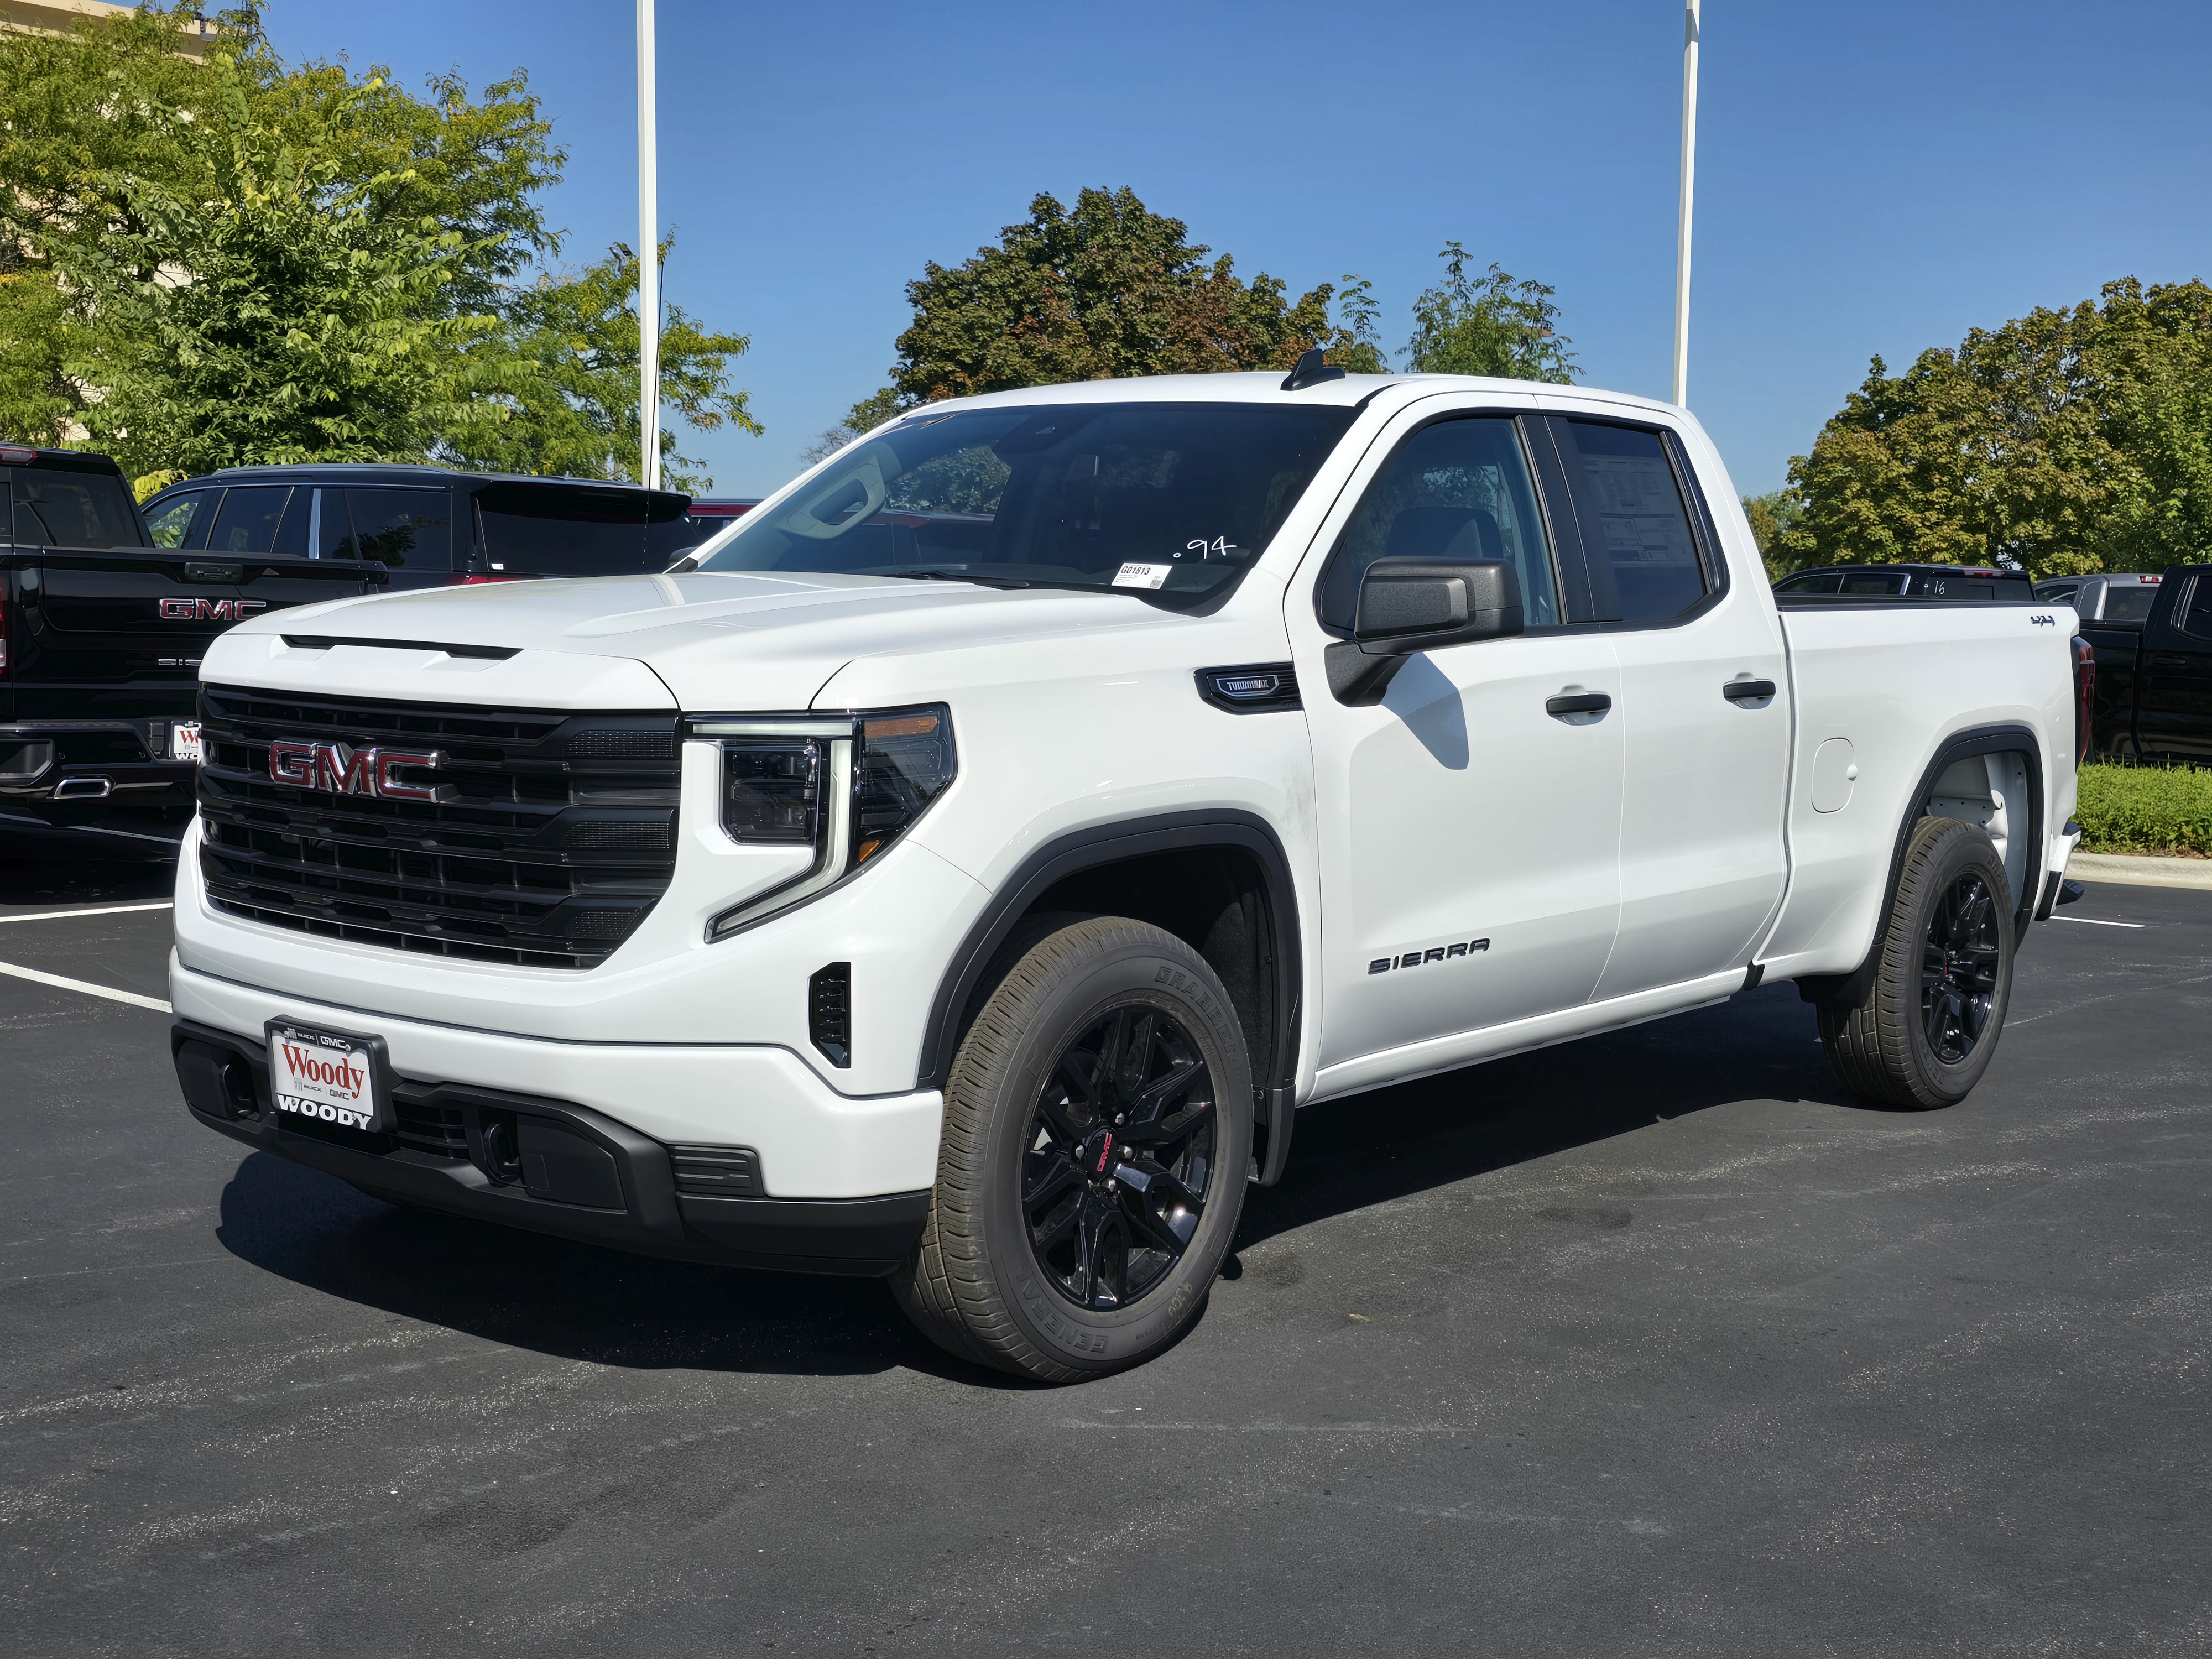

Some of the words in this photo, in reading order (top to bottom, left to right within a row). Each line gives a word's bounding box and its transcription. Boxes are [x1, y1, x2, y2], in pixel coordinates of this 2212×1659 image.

[159, 598, 267, 620] GMC
[269, 740, 438, 804] GMC
[1367, 938, 1490, 975] SIERRA
[1154, 966, 1239, 1063] GRABBER
[320, 1036, 346, 1048] GMC
[281, 1044, 365, 1099] Woody
[277, 1094, 372, 1130] WOODY
[330, 1089, 349, 1100] GMC
[1097, 1131, 1113, 1171] GMC
[1016, 1274, 1109, 1353] GENERAL
